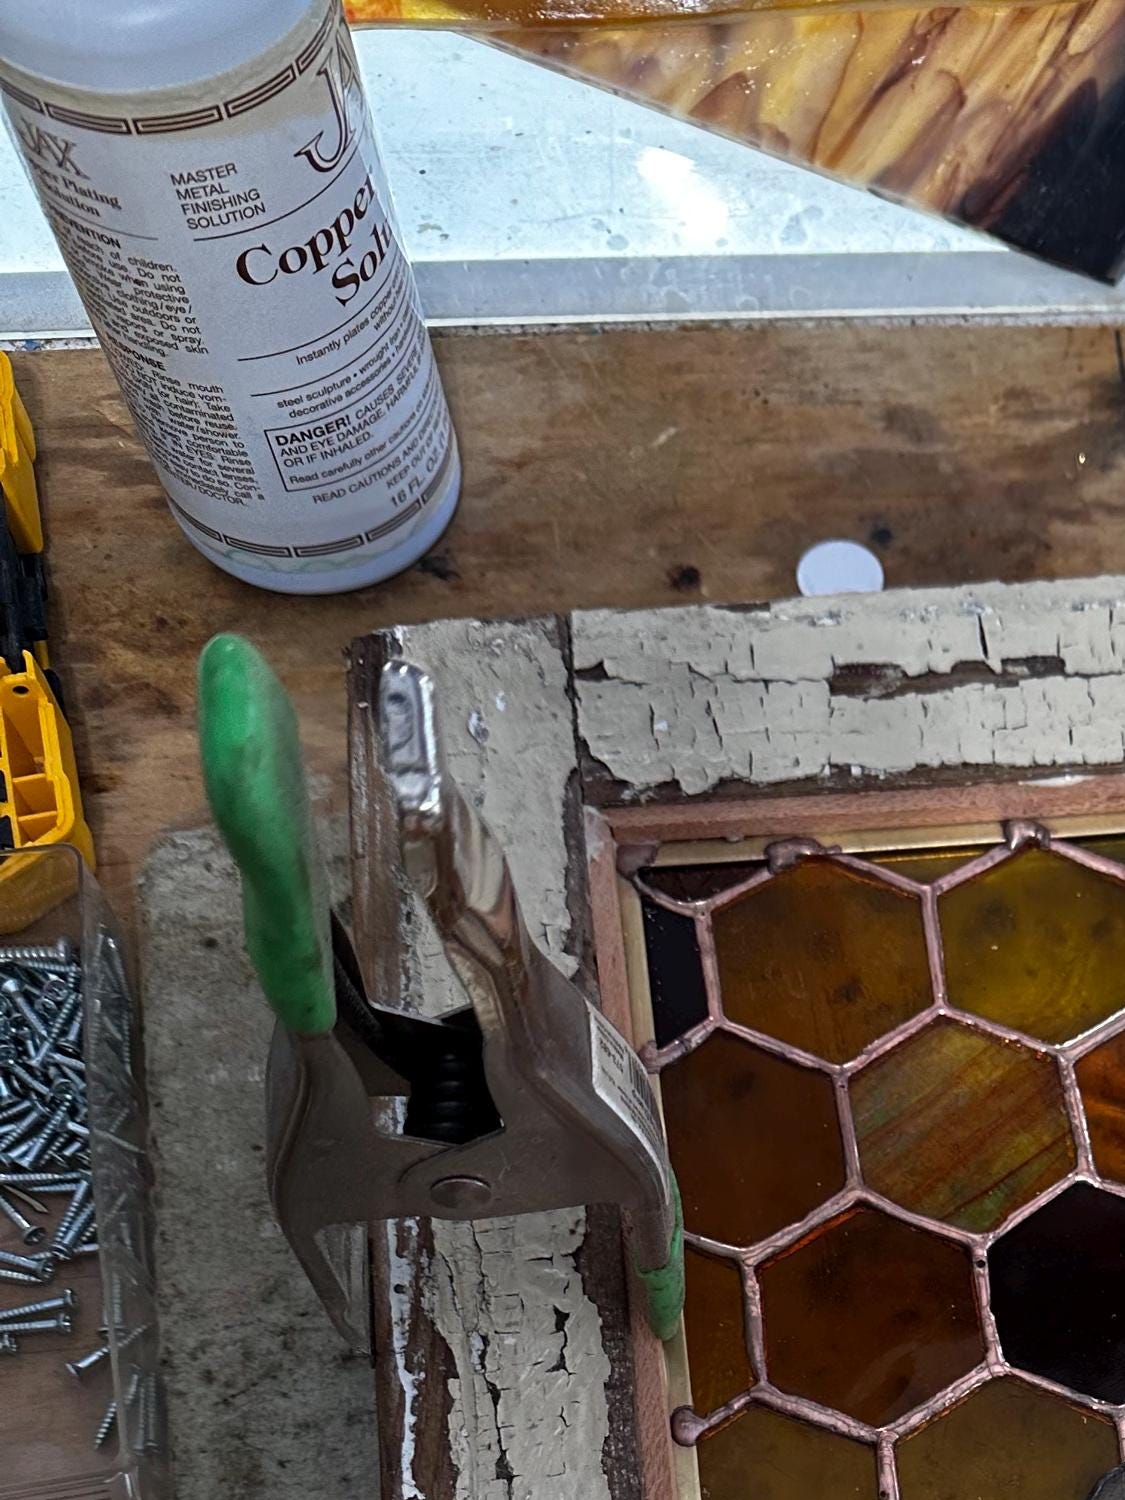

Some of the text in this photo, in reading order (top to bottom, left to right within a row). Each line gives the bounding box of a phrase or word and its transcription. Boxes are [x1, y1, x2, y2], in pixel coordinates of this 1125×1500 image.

[170, 162, 238, 186] MASTER
[176, 183, 230, 200] METAL
[181, 188, 260, 215] FINISHING
[186, 202, 266, 230] SOLUTION
[110, 251, 121, 261] of
[127, 256, 177, 272] children.
[137, 268, 155, 280] Do
[162, 273, 182, 283] not
[133, 287, 190, 304] protective
[154, 283, 186, 296] using
[131, 305, 180, 323] outdoors
[184, 317, 197, 325] or
[160, 320, 177, 332] Do
[182, 323, 201, 334] not
[171, 334, 204, 344] spray.
[296, 338, 342, 366] Instantly
[343, 318, 370, 345] plates
[185, 344, 209, 355] skin
[277, 395, 304, 409] steel
[306, 375, 351, 402] sculpture
[358, 342, 390, 375] wrought
[188, 382, 224, 393] mouth
[288, 395, 343, 419] decorative
[345, 359, 392, 399] accessories
[163, 399, 234, 421] contaminated
[206, 403, 231, 412] Take
[274, 414, 351, 447] DANGER!
[355, 384, 395, 420] CAUSES
[186, 439, 248, 457] comfortable
[192, 433, 228, 447] person
[232, 440, 245, 449] to
[280, 442, 309, 457] AND
[311, 434, 336, 451] EYE
[283, 431, 373, 468] OR IF INHALED.
[220, 455, 252, 466] Rinse
[289, 471, 319, 485] Read
[320, 456, 363, 479] carefully
[364, 441, 388, 460] other
[312, 489, 347, 504] READ
[348, 455, 401, 493] CAUTIONS
[386, 465, 410, 489] KEEP
[390, 490, 407, 507] 16
